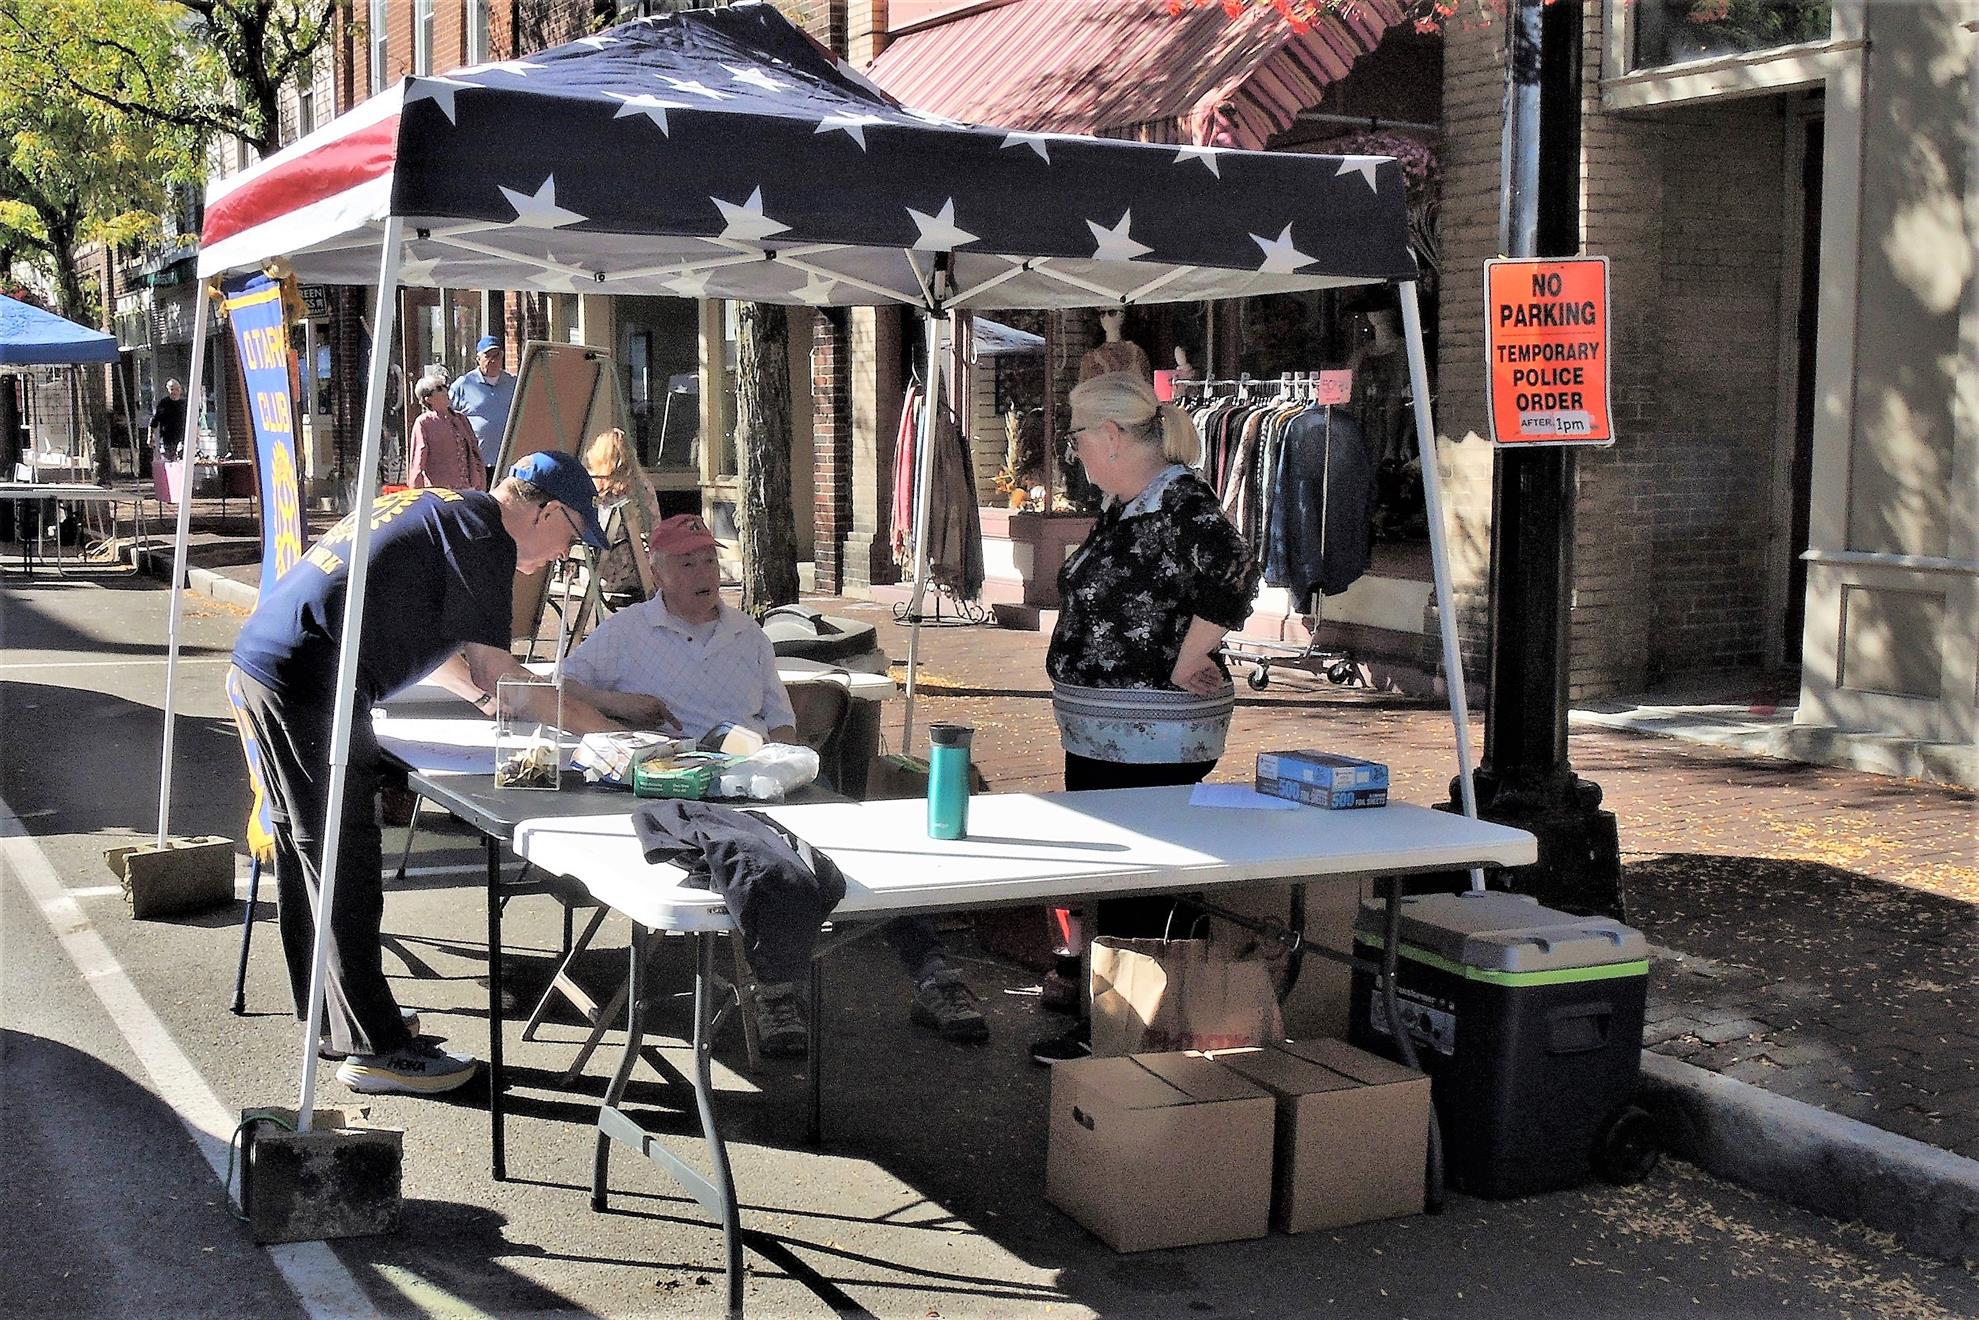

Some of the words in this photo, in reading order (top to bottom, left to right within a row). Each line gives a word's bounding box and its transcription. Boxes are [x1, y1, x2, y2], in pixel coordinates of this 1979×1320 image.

[299, 288, 322, 298] REEN
[1532, 273, 1562, 298] NO
[1500, 301, 1597, 328] PARKING
[1497, 342, 1600, 363] TEMPORARY
[1513, 367, 1584, 387] POLICE
[256, 391, 291, 432] CLUB
[1516, 391, 1583, 412] ORDER
[1555, 418, 1585, 433] 1pm
[1332, 791, 1355, 808] 500
